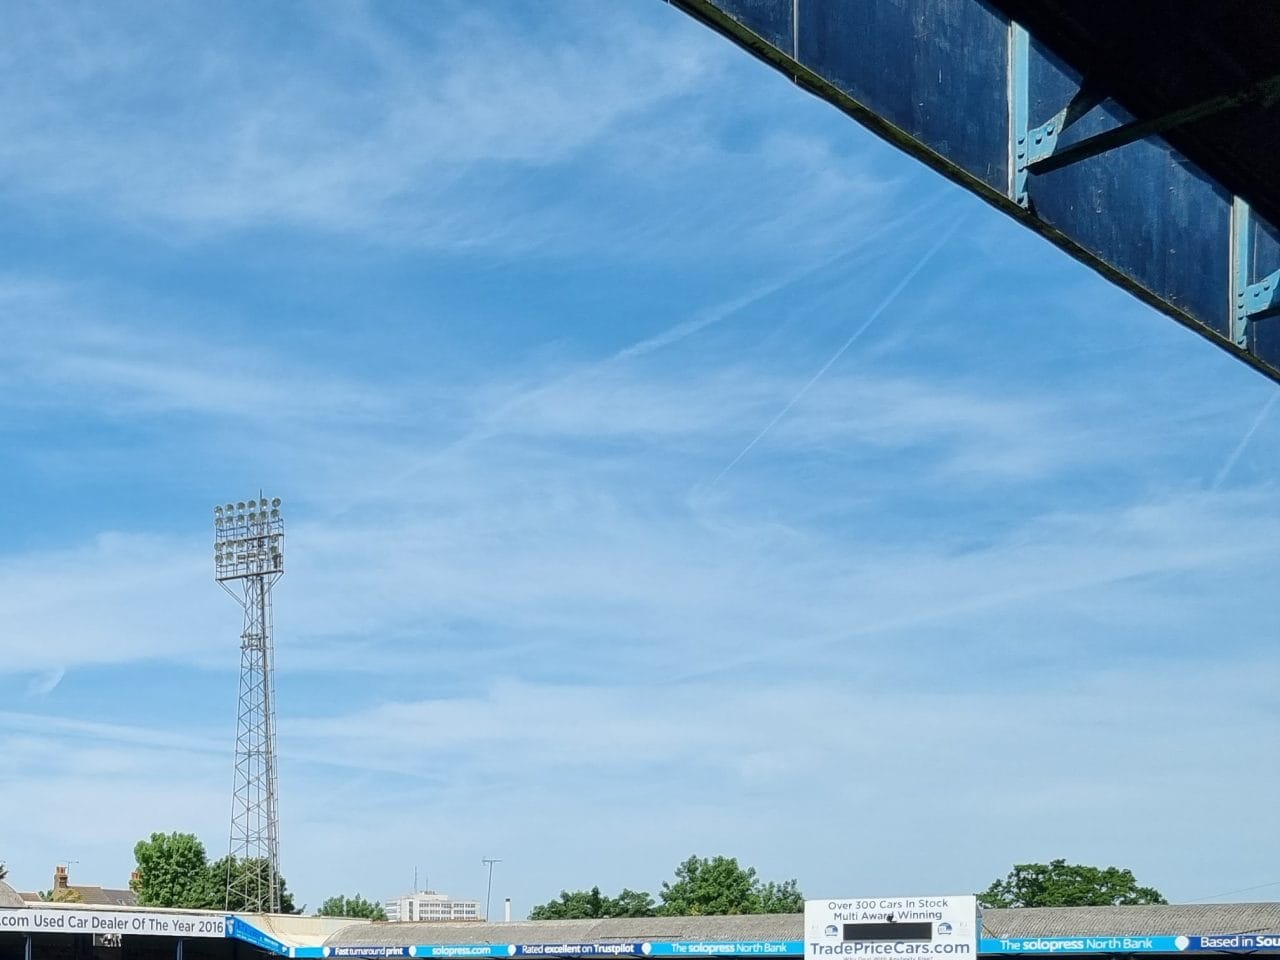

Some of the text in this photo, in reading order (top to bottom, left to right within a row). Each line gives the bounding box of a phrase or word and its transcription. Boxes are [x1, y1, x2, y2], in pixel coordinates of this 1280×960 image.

[828, 898, 948, 910] Over 300 Cars In Stock
[834, 910, 942, 921] Multi Award Winning
[34, 914, 64, 928] Used
[68, 916, 88, 929] Car
[92, 916, 128, 930] Dealer
[132, 918, 145, 930] Of
[149, 918, 168, 931] The
[172, 920, 195, 932] Year
[199, 921, 223, 933] 2016
[1001, 938, 1152, 952] The solopress North Bank
[1201, 936, 1238, 947] Based
[1242, 936, 1253, 947] in
[335, 947, 403, 957] Fast turnaround print
[432, 945, 491, 957] solopress.com
[522, 945, 543, 954] Rated
[544, 944, 581, 953] excellent
[594, 944, 634, 955] Trustpilot
[671, 942, 788, 954] The solopress North Bank
[810, 941, 970, 955] TradePriceCars.com
